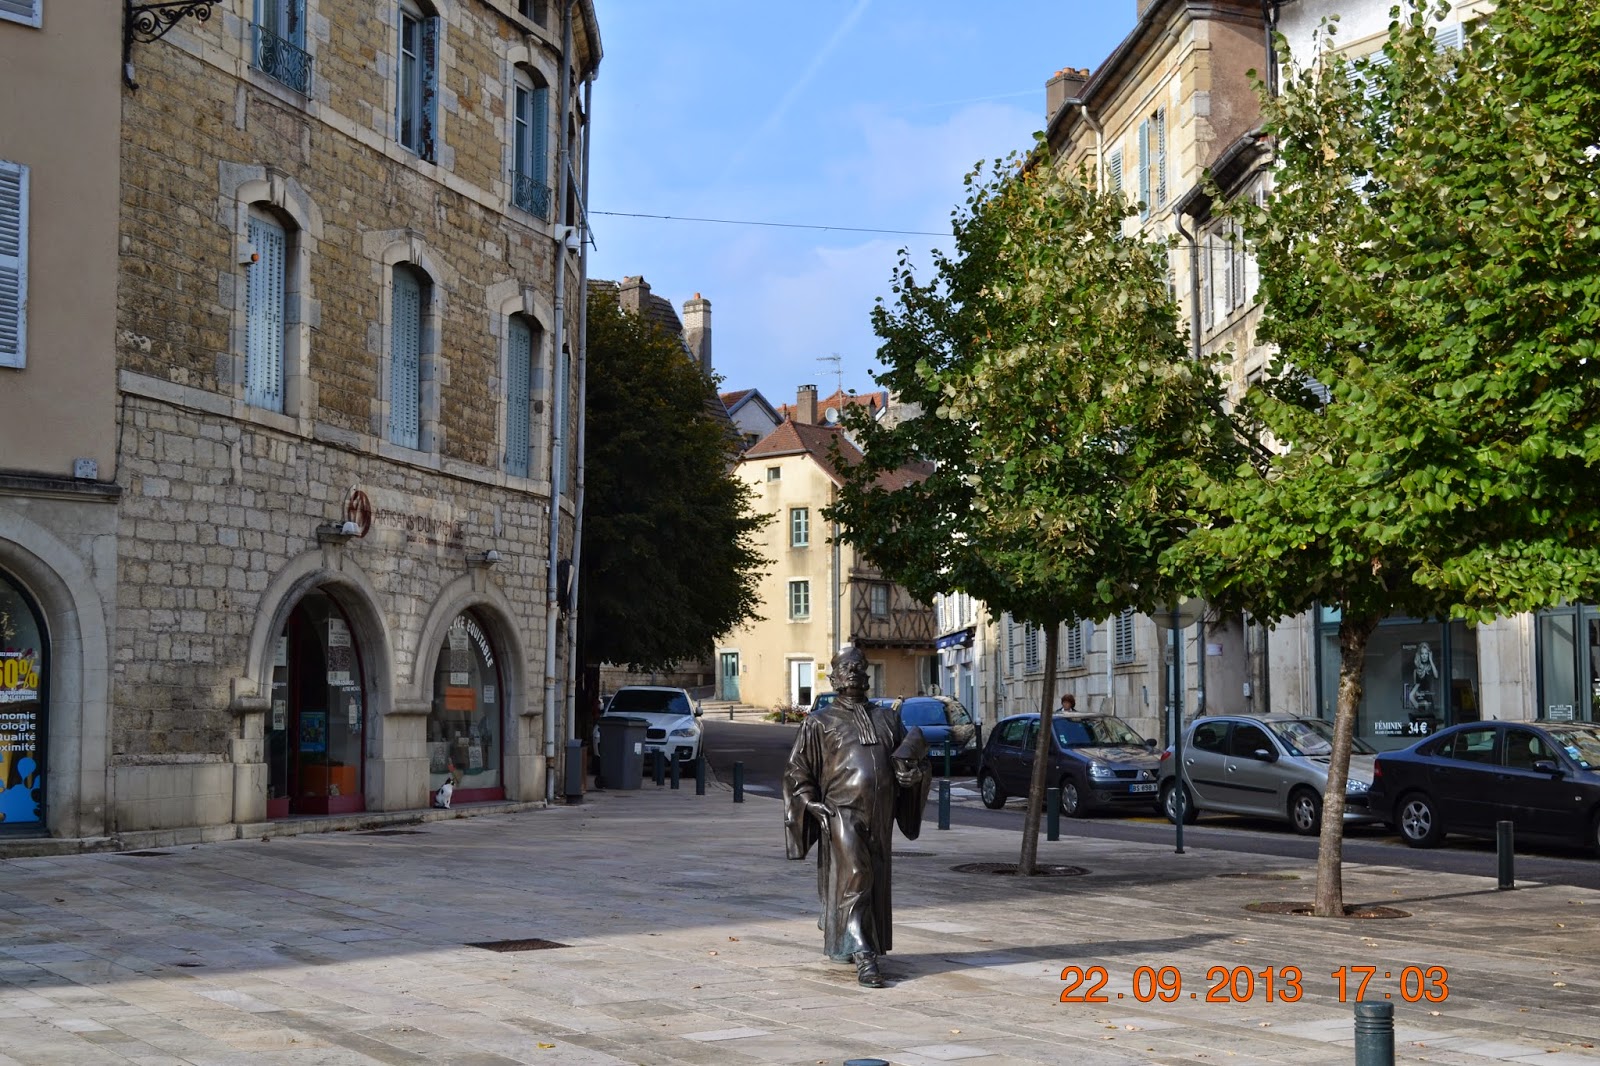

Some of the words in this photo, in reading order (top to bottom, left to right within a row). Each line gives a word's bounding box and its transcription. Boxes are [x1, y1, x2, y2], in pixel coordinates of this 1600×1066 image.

[374, 508, 414, 531] ARTISANS
[417, 516, 430, 533] DU
[466, 619, 494, 668] EQUITABLE
[0, 658, 39, 688] 0%
[0, 711, 36, 720] nomie
[0, 722, 36, 731] ologie
[1374, 720, 1402, 730] FÉMININ
[0, 743, 36, 751] ximité
